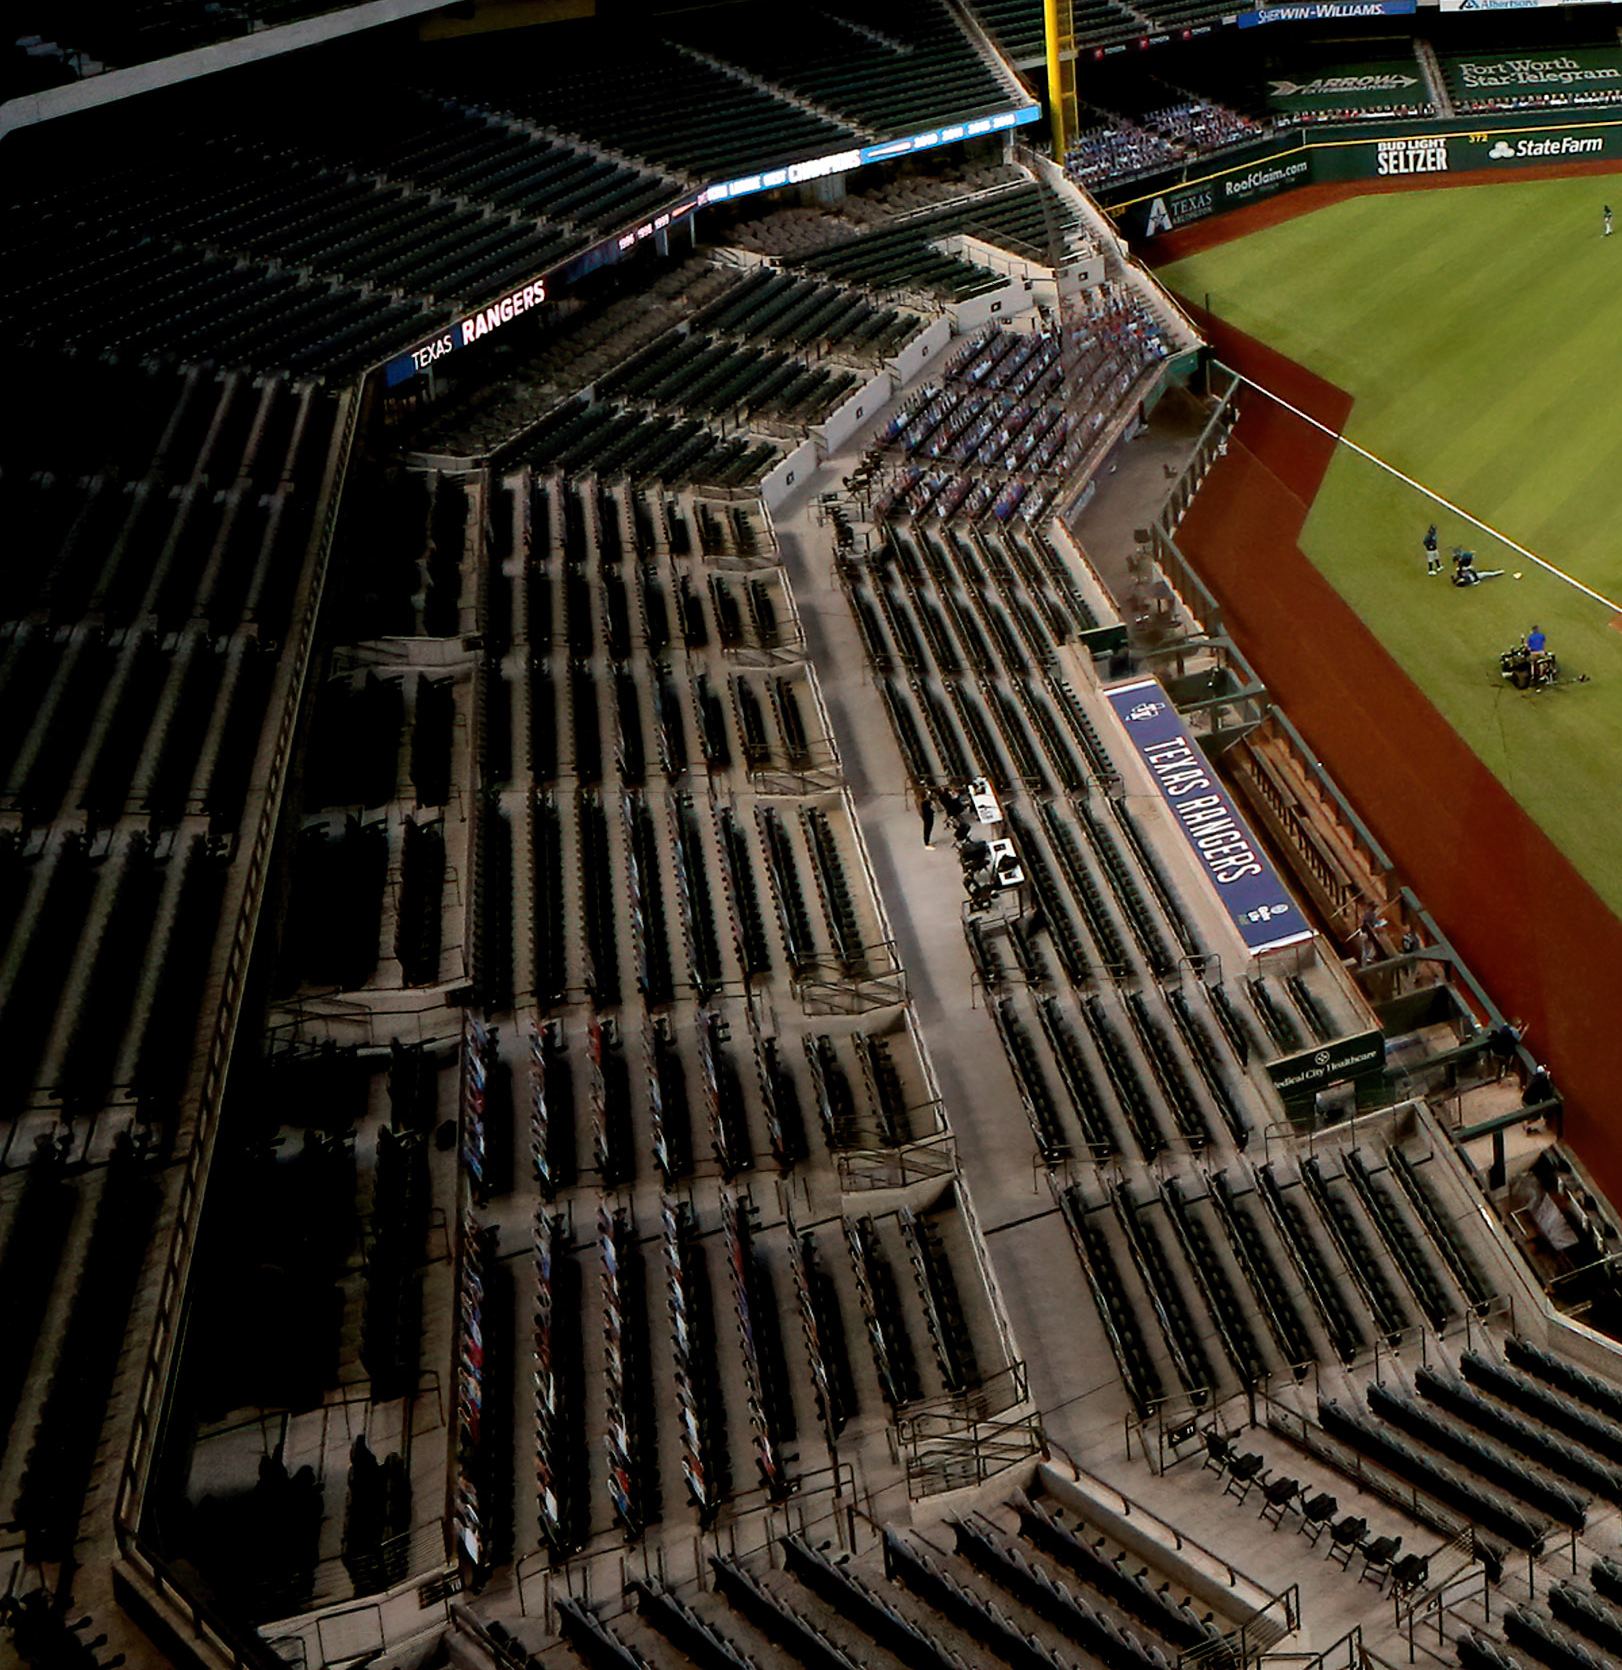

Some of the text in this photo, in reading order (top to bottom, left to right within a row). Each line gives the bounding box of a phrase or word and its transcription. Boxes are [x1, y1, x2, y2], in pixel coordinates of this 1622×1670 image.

[1460, 56, 1580, 77] Fort Worth
[1462, 66, 1622, 89] Star-Telegram
[1377, 138, 1447, 152] BUD LIGHT
[1376, 147, 1449, 176] SELTZER
[1225, 161, 1309, 197] RoofClaim.com
[1171, 191, 1214, 217] TEXAS
[411, 279, 547, 372] TEXAS RANGERS
[1144, 736, 1264, 885] TEXAS RANGERS
